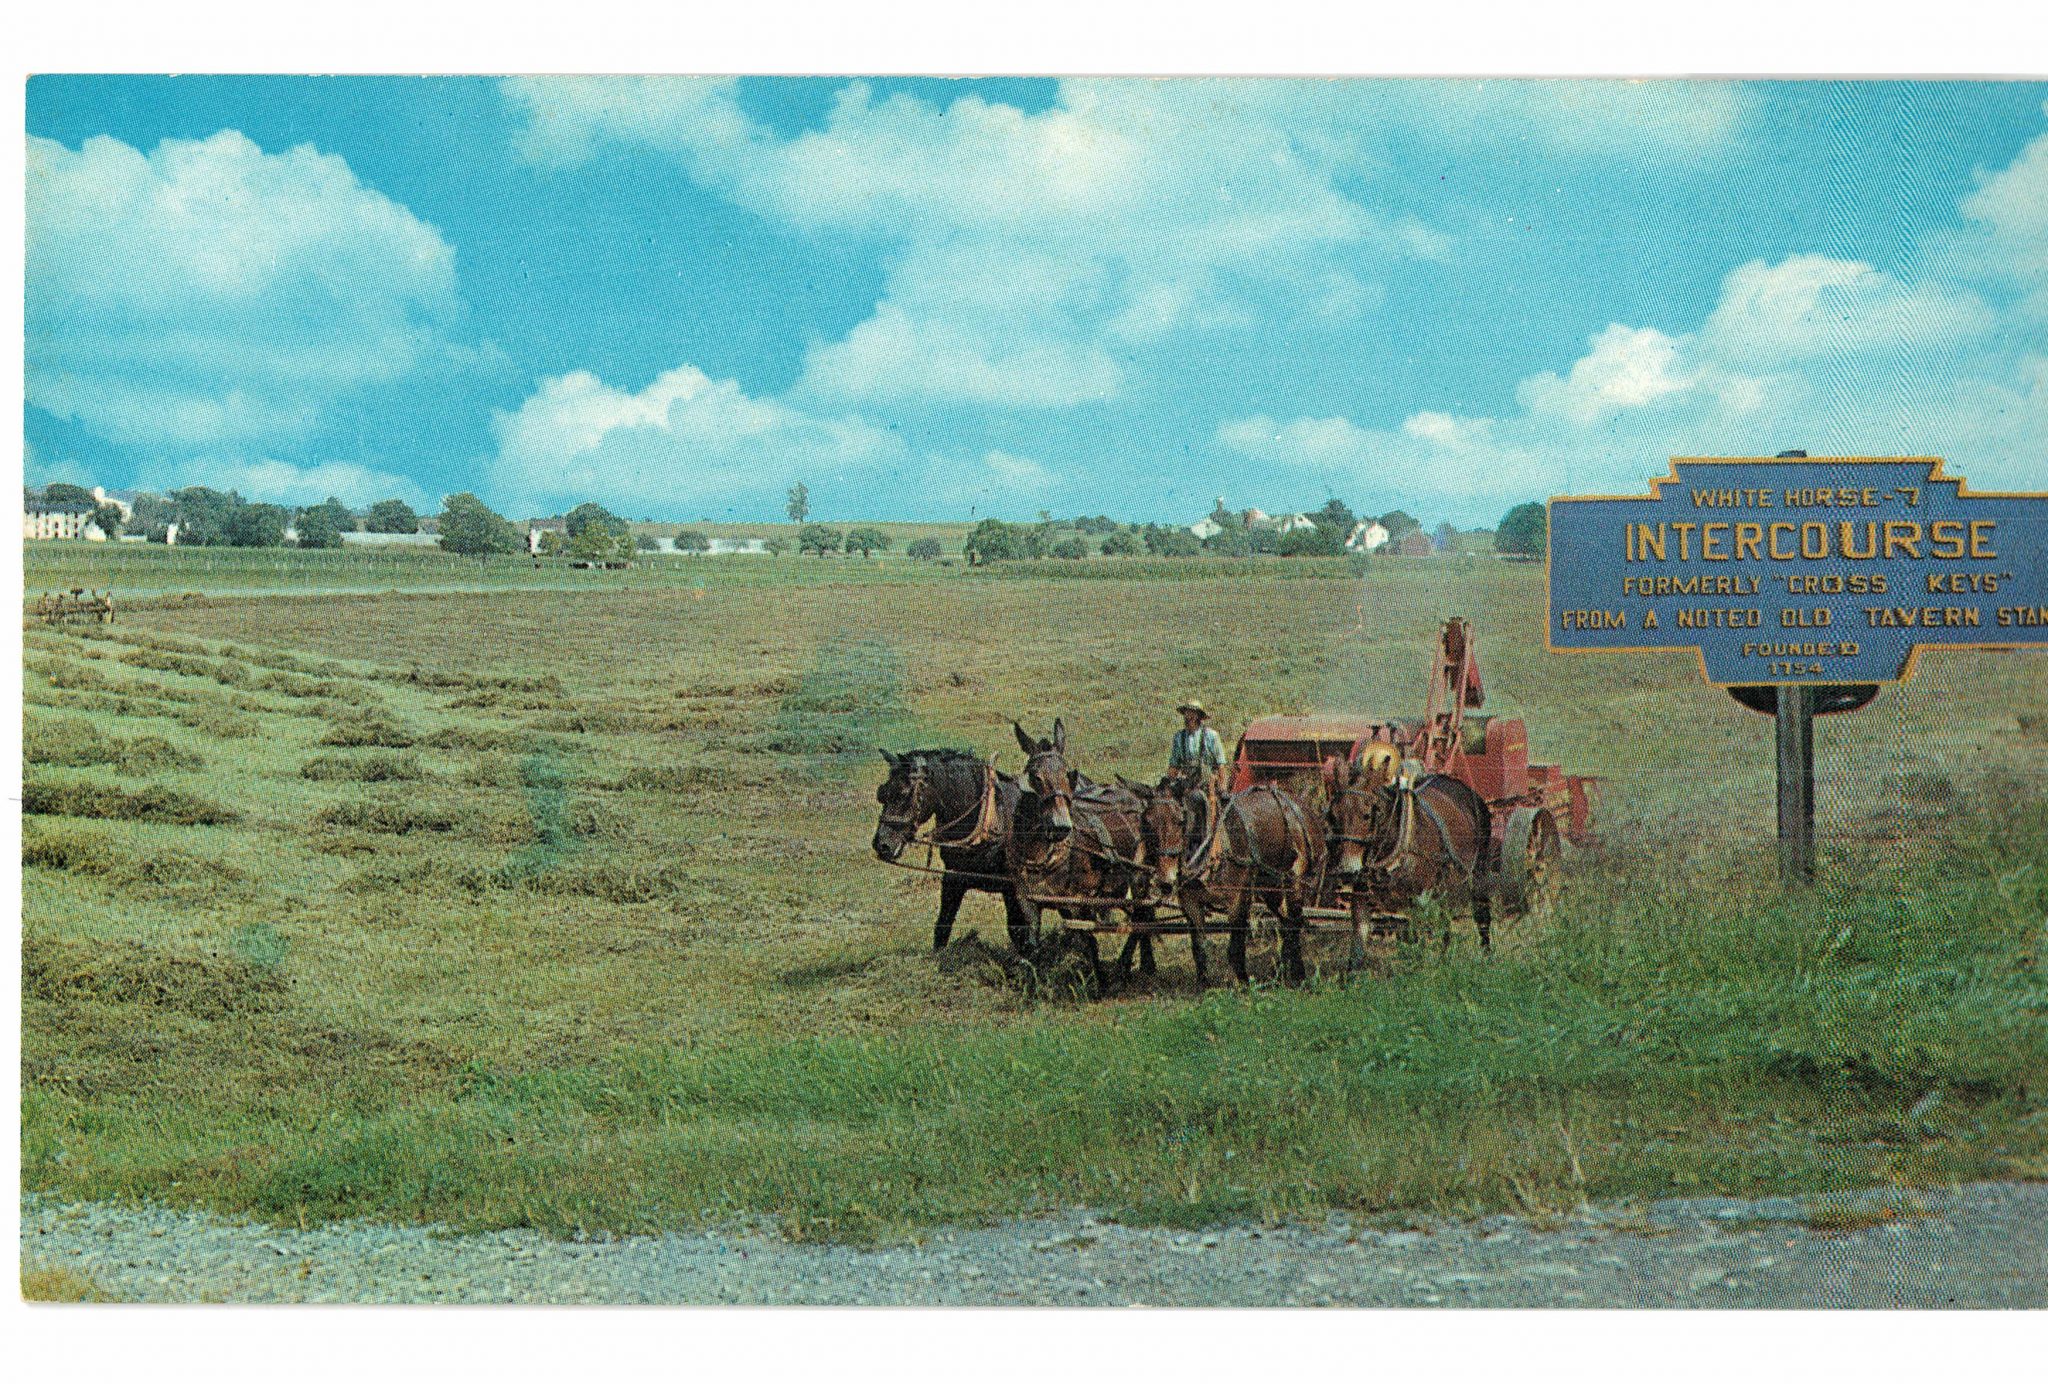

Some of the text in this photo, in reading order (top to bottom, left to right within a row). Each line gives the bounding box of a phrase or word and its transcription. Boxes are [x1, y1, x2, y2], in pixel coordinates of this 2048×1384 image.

[1691, 487, 1773, 508] WHITE
[1625, 521, 1998, 561] INTERCOURSE
[1623, 575, 1761, 595] FORMERLY
[1562, 610, 1626, 629] FROM
[1643, 610, 1658, 629] A
[1678, 609, 1762, 628] NOTED
[1781, 608, 1832, 627] OLD
[1866, 607, 1980, 627] TAVERN
[1743, 642, 1860, 657] FOUNDED
[1769, 662, 1823, 676] 1754
